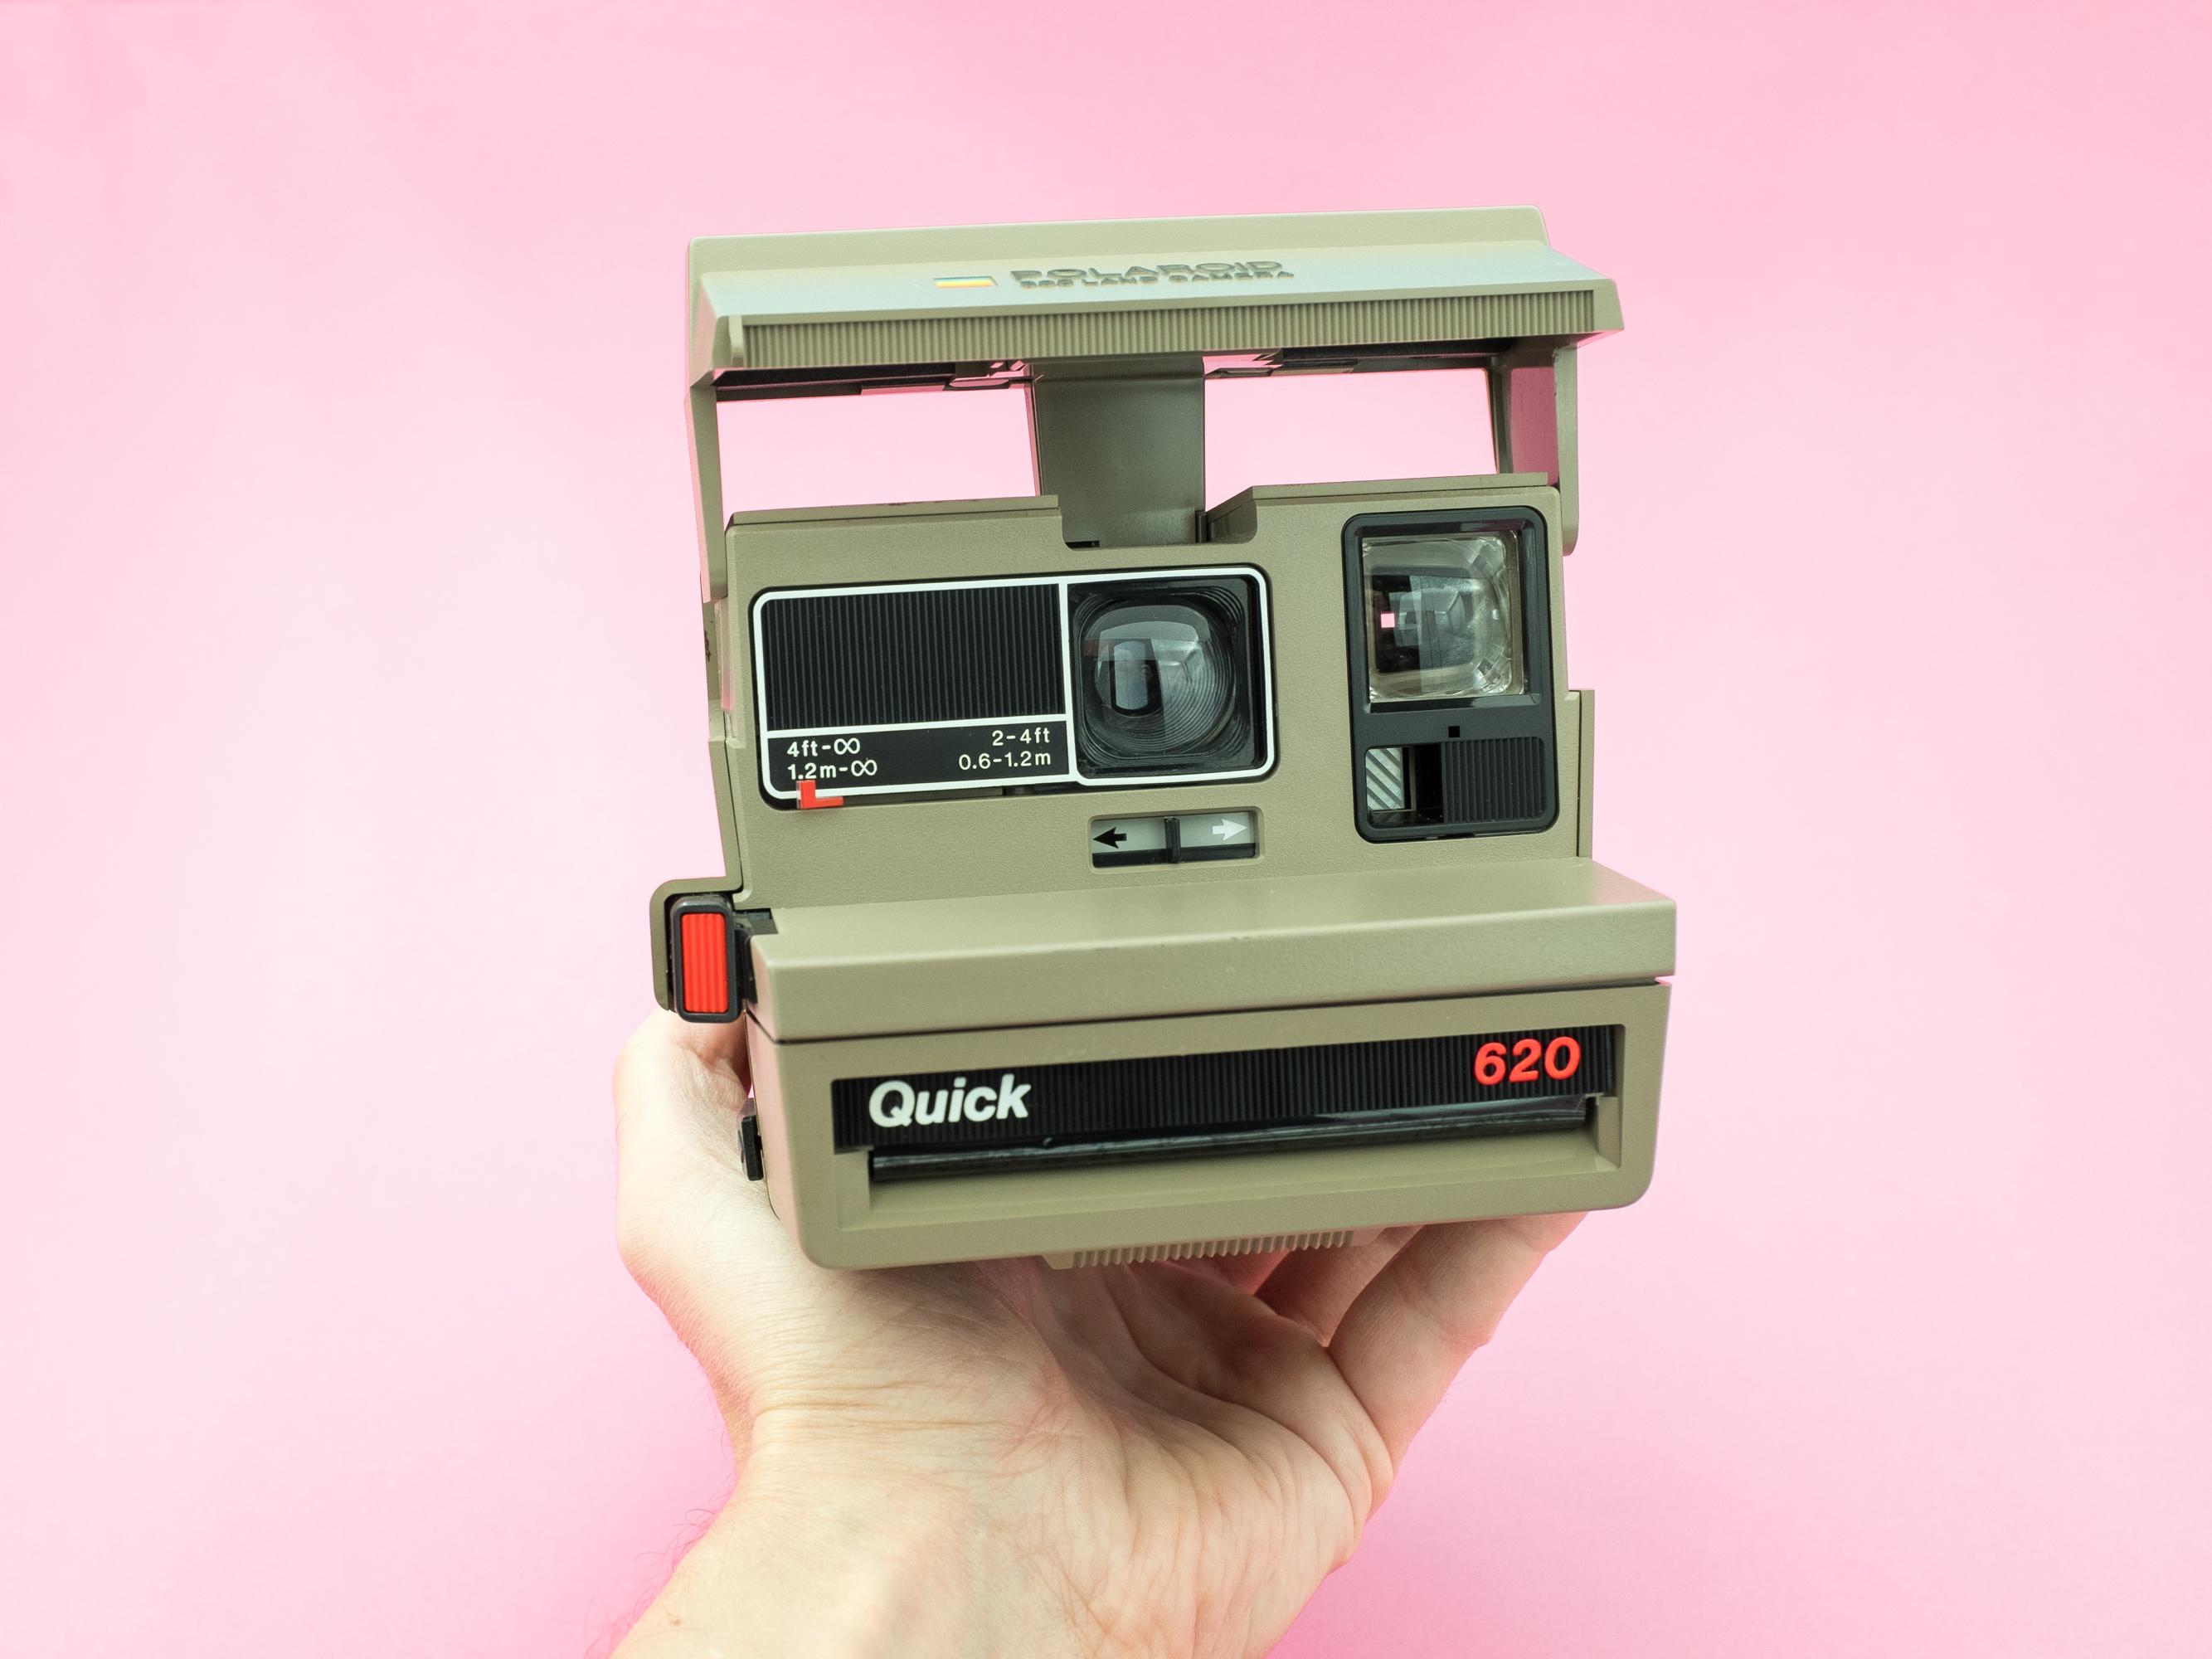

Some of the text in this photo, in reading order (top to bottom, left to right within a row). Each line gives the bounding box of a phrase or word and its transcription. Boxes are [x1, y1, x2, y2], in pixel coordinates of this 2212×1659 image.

[1010, 260, 1282, 280] POLAROID
[992, 727, 1050, 746] 2-4ft
[959, 751, 1051, 770] 0.6-1.2m
[869, 1037, 1581, 1127] Quick 620
